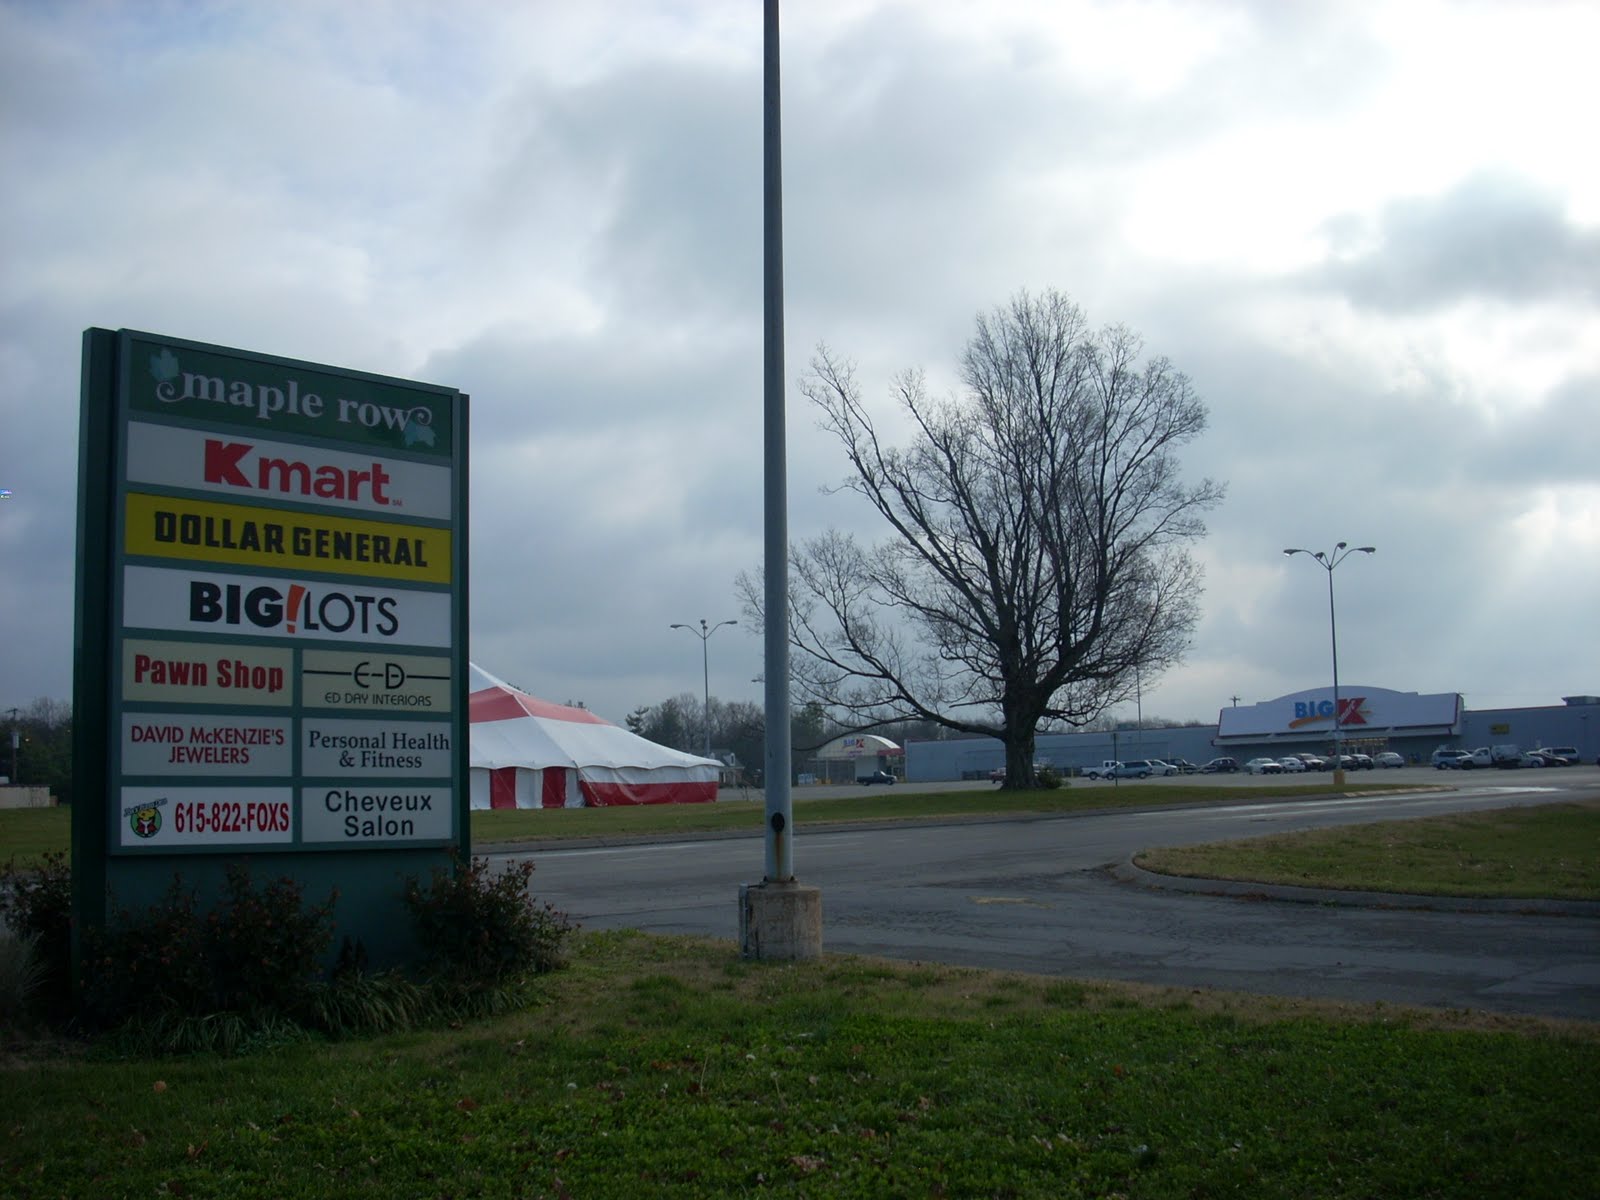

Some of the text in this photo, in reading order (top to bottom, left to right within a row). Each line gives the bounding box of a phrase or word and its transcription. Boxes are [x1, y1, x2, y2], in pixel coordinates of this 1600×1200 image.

[156, 371, 432, 432] maple row
[204, 438, 390, 505] Kmart
[154, 511, 428, 567] DOLLAR GENERAL
[134, 654, 284, 693] Pawn Shop
[325, 691, 432, 707] ED DAY INTERIORS
[1295, 700, 1334, 718] BIG
[1337, 697, 1367, 725] K
[131, 725, 285, 746] DAVID McKENZIE'S
[309, 730, 450, 750] Personal Health
[168, 746, 250, 764] JEWELERS
[339, 750, 422, 769] & Fitness
[325, 790, 432, 812] Cheveux
[174, 802, 289, 833] 615-822-FOXS
[344, 815, 414, 838] Salon
